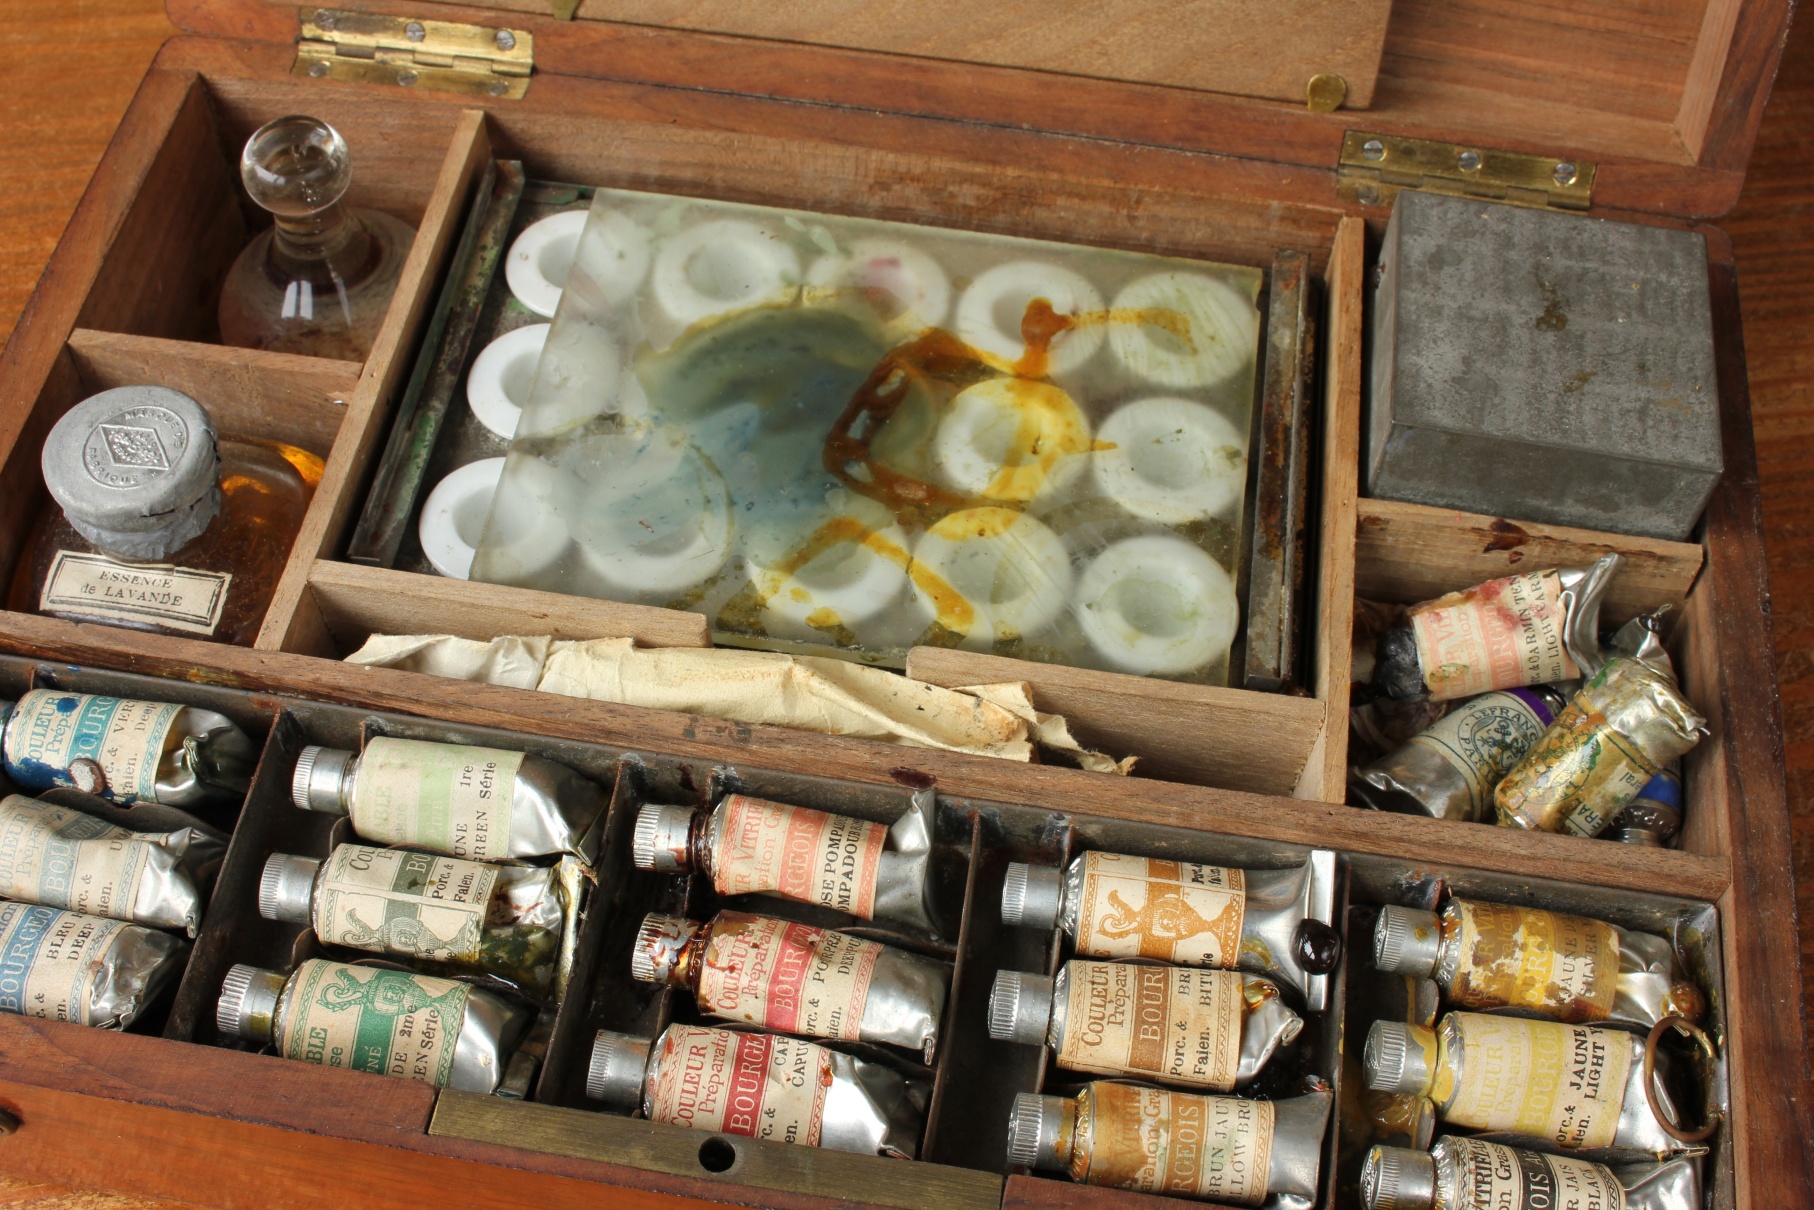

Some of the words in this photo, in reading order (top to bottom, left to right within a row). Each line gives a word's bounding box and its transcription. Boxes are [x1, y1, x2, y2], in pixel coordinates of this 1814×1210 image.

[80, 582, 96, 595] de
[104, 586, 183, 607] LAVANDE
[99, 570, 173, 589] ESSENCE
[29, 695, 59, 762] OULEUR
[109, 746, 119, 758] &
[479, 760, 498, 800] Série
[81, 873, 93, 885] &
[431, 870, 453, 900] Porc.
[0, 904, 54, 1011] BOURGEO
[67, 922, 95, 961] DEEP
[34, 992, 46, 1004] &
[808, 997, 821, 1009] &
[1081, 965, 1109, 1046] COULEUR
[399, 1004, 418, 1038] 2me
[419, 1008, 440, 1051] Série
[826, 1005, 843, 1039] aien.
[1170, 1035, 1187, 1077] Porc.
[1179, 1020, 1188, 1031] &
[1194, 1026, 1211, 1076] Faien.
[1569, 1029, 1588, 1091] JAUNE
[671, 1044, 709, 1128] COULEUR
[1584, 1043, 1606, 1101] LIGHT
[763, 1106, 777, 1118] &
[1171, 1104, 1200, 1194] RGEOIS
